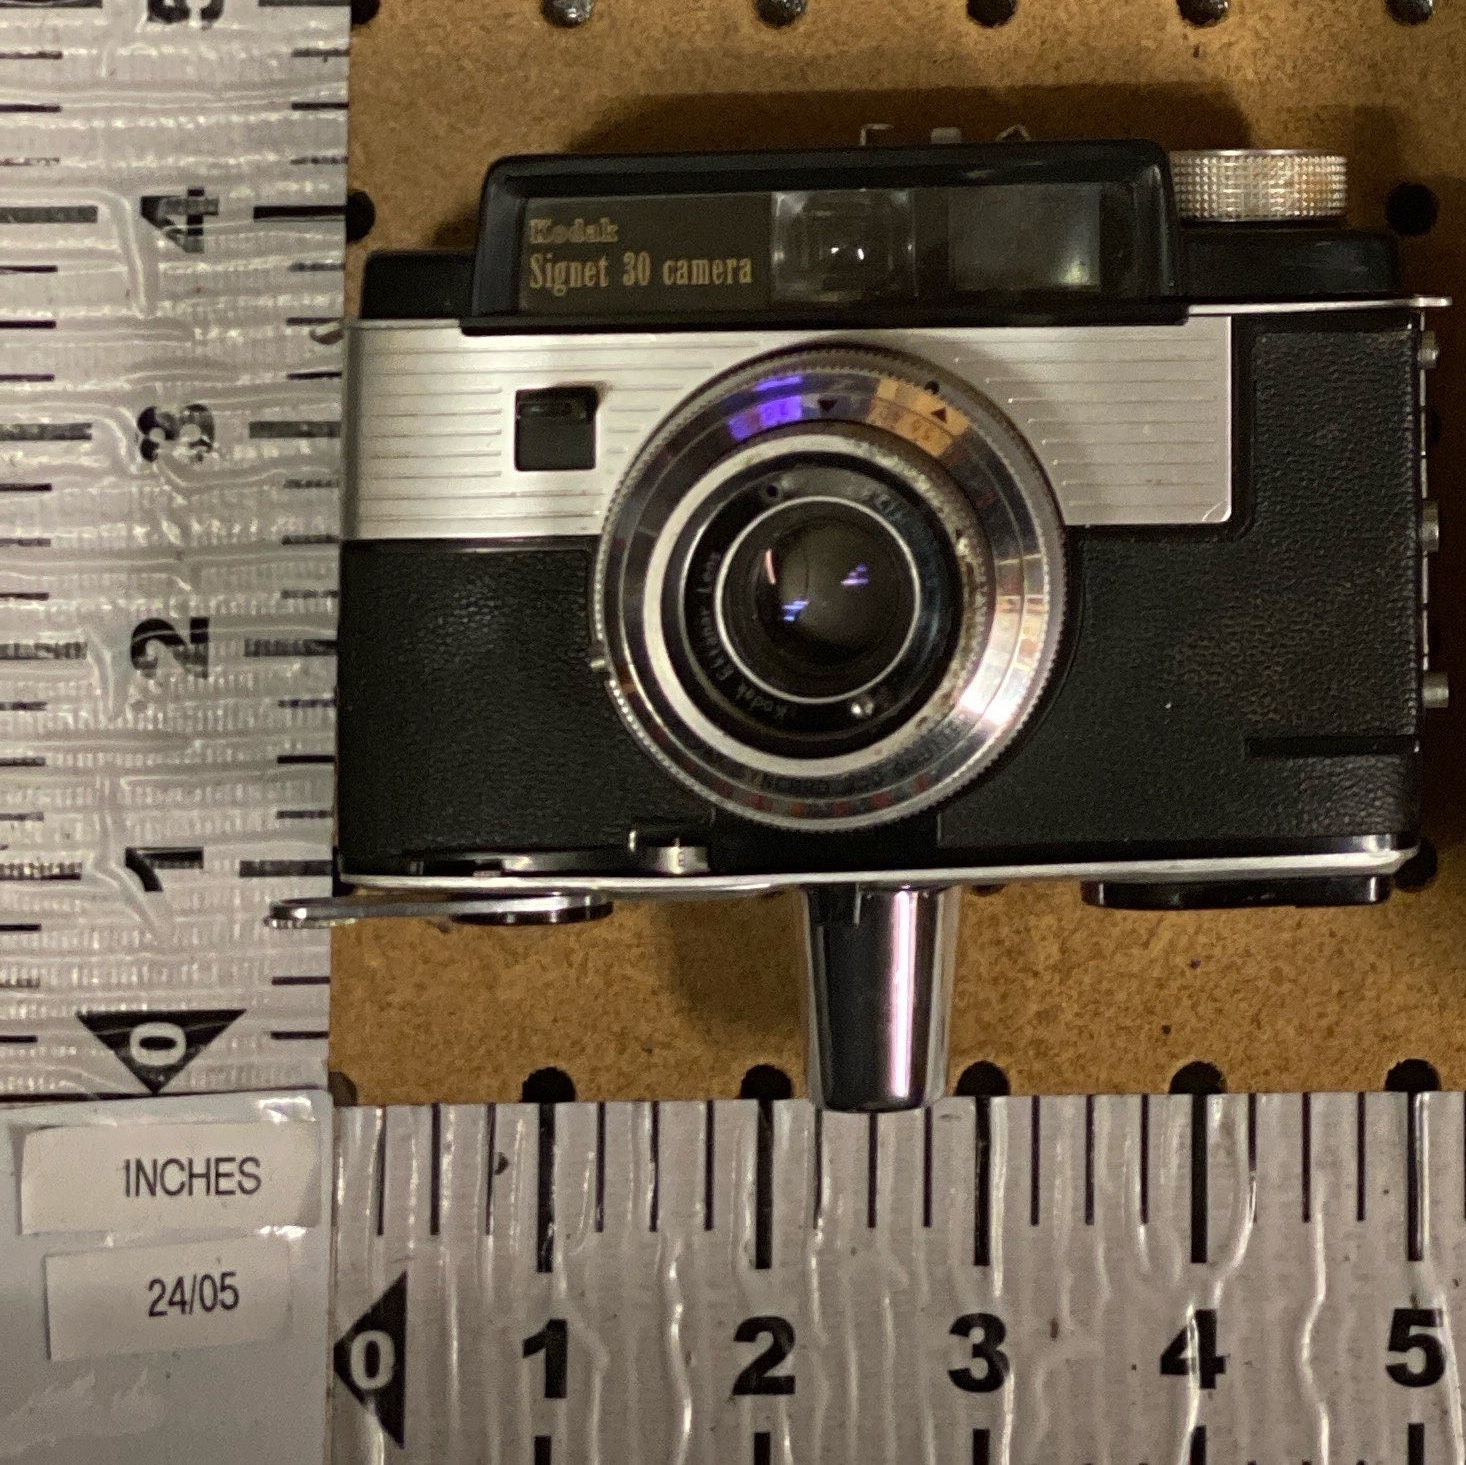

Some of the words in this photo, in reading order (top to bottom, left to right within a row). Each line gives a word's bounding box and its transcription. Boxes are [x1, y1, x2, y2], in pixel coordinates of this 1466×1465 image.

[140, 188, 220, 253] 4
[529, 216, 619, 244] Kodak
[529, 252, 609, 297] Signet
[622, 250, 650, 286] 30
[662, 257, 752, 285] camera
[137, 404, 215, 464] 3
[130, 617, 209, 678] 2
[125, 846, 204, 892] 1
[129, 1022, 187, 1066] 0
[124, 1156, 262, 1198] INCHES
[147, 1272, 240, 1318] 24/05
[348, 1330, 396, 1391] 0
[522, 1318, 568, 1399] 1
[732, 1315, 797, 1396] 2
[948, 1313, 1011, 1392] 3
[1159, 1308, 1226, 1390] 4
[1384, 1308, 1446, 1387] 5
